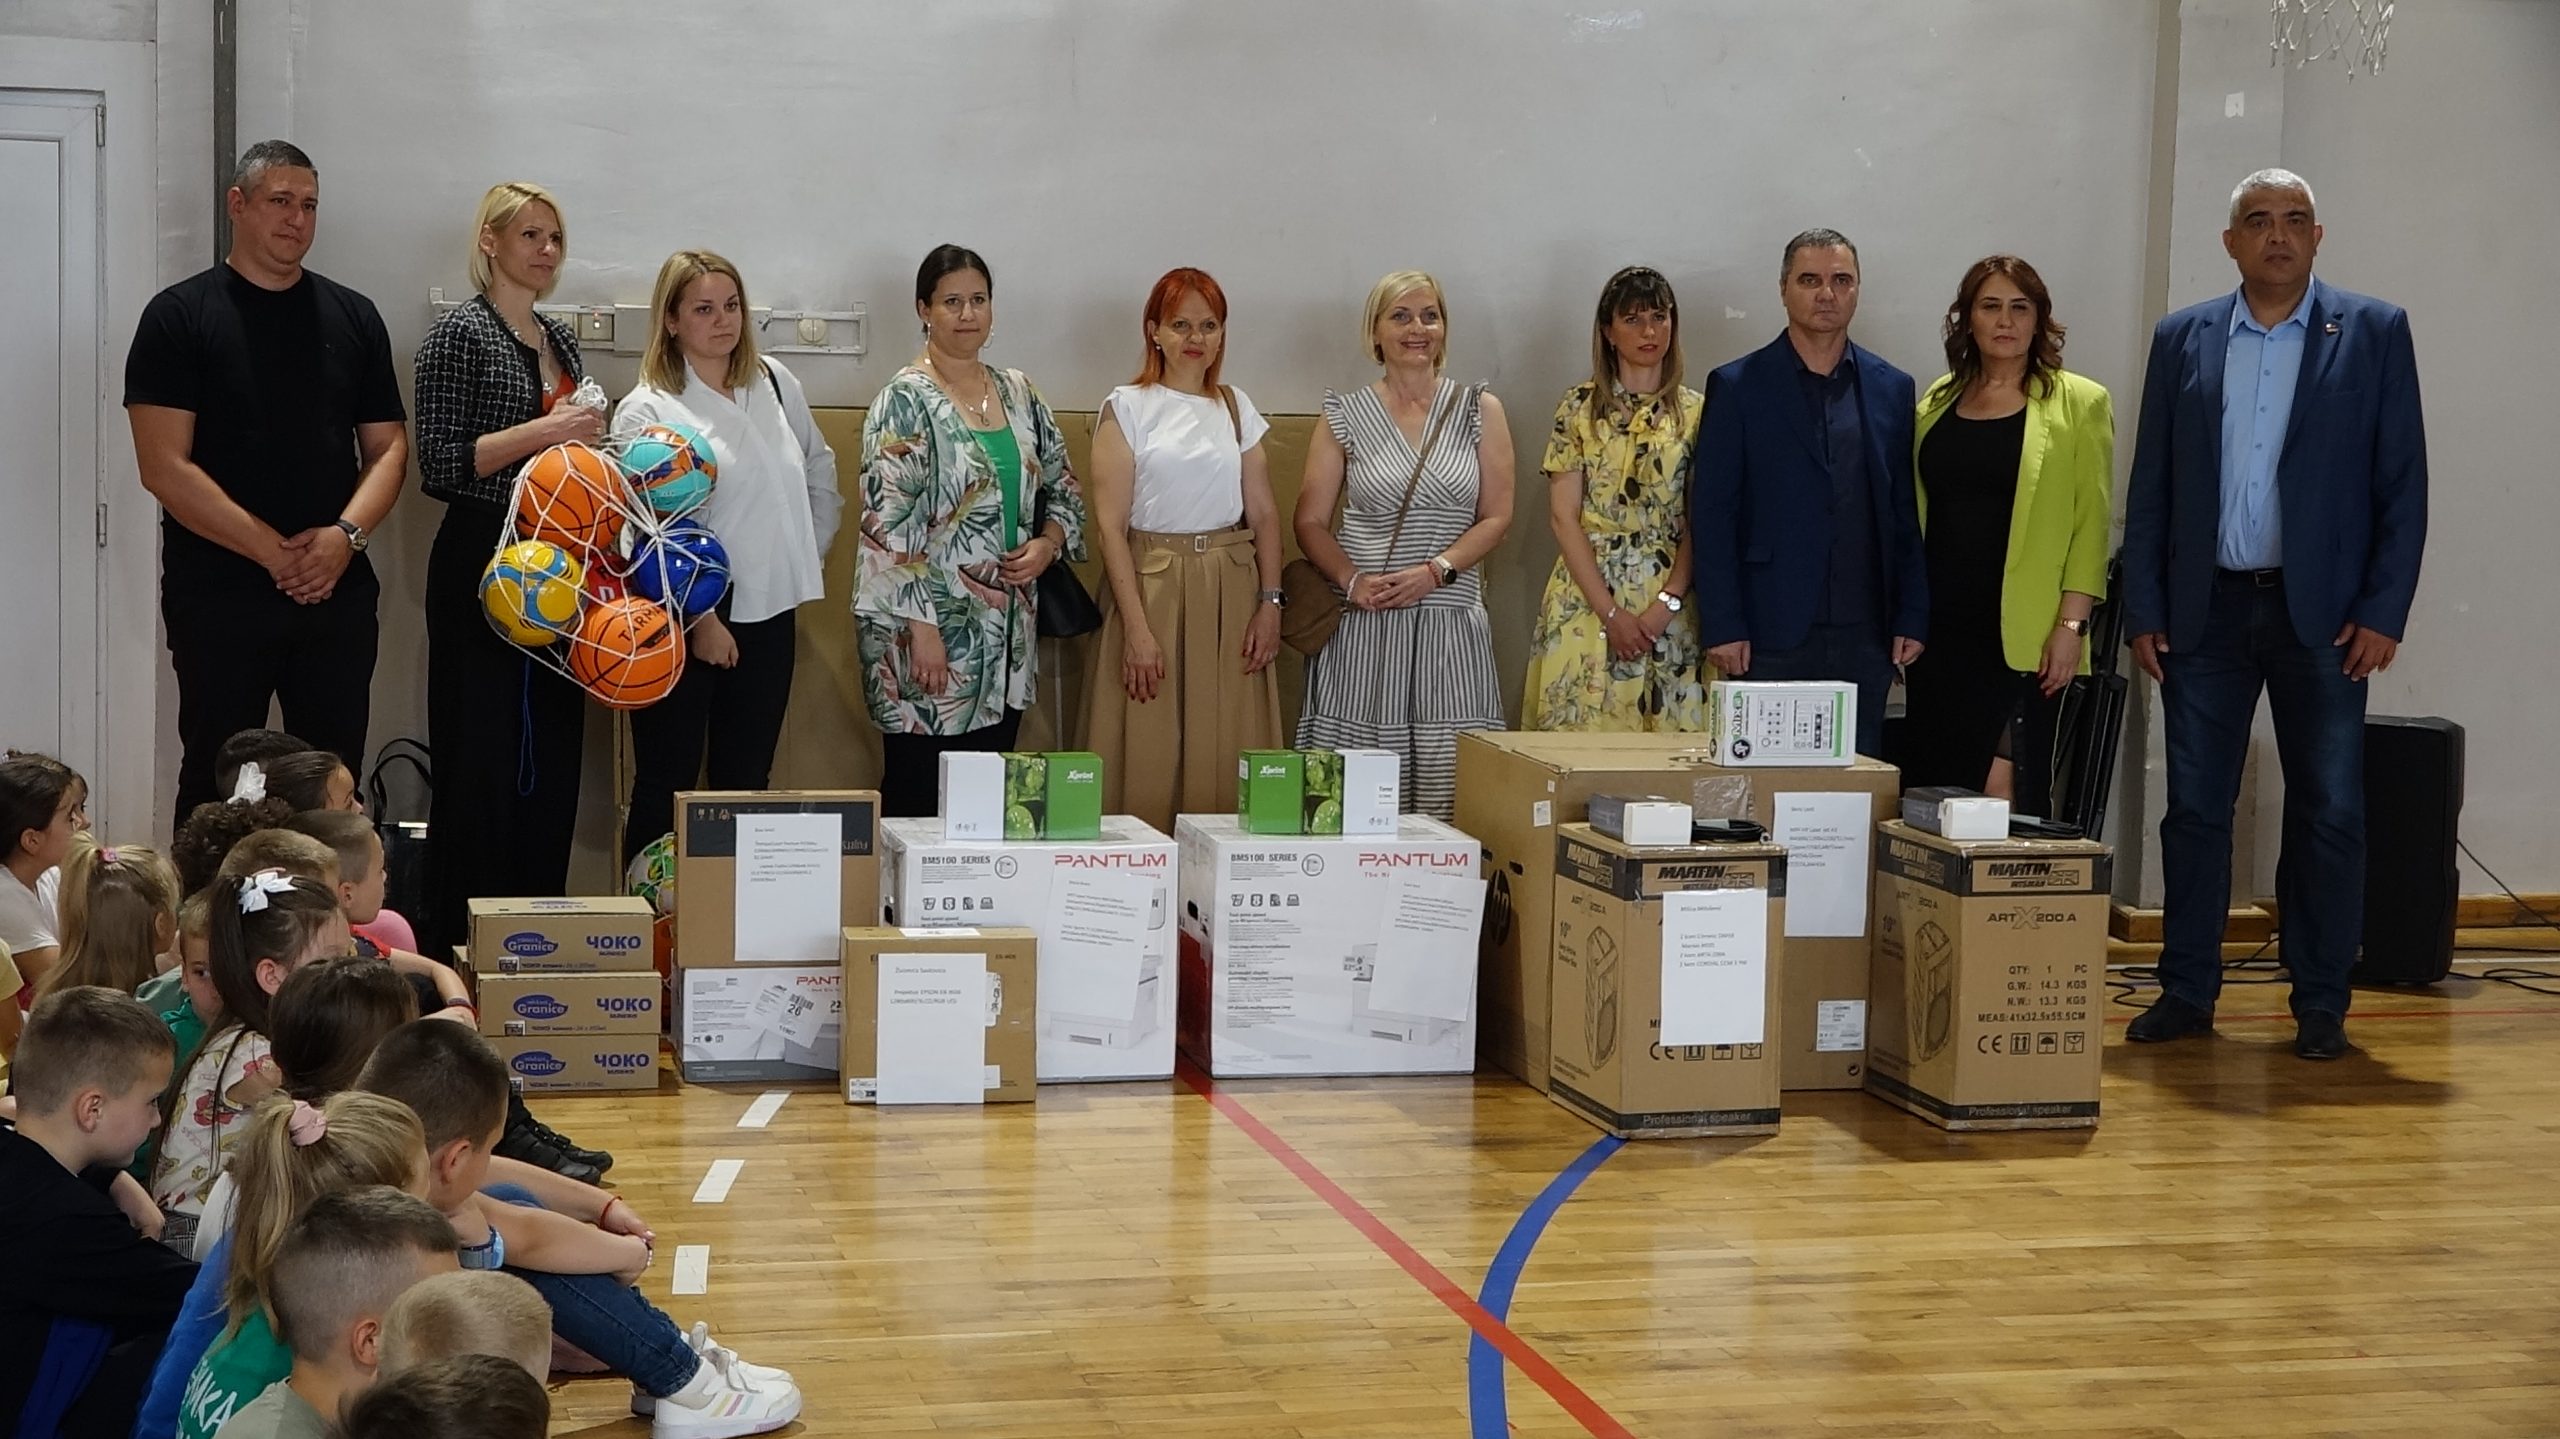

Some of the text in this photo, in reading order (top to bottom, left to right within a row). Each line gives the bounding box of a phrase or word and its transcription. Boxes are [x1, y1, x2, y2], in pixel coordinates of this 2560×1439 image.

[1054, 853, 1167, 868] PANTUM
[1359, 852, 1468, 867] PANTUM
[1657, 865, 1727, 879] MARTIN
[1987, 863, 2053, 876] MARTIN
[586, 935, 641, 950] ЧОКО
[2008, 965, 2030, 975] QTY:
[2074, 964, 2088, 973] PC
[796, 976, 842, 985] PANT
[2040, 980, 2060, 989] 14.3
[2066, 980, 2087, 989] KGS
[596, 998, 652, 1012] ЧОКО
[2039, 996, 2058, 1006] 13.3
[2065, 996, 2086, 1005] KGS
[594, 1053, 650, 1067] ЧОКО
[1968, 1105, 2073, 1117] Professional speaker
[1643, 1112, 1751, 1126] Professional speaker
